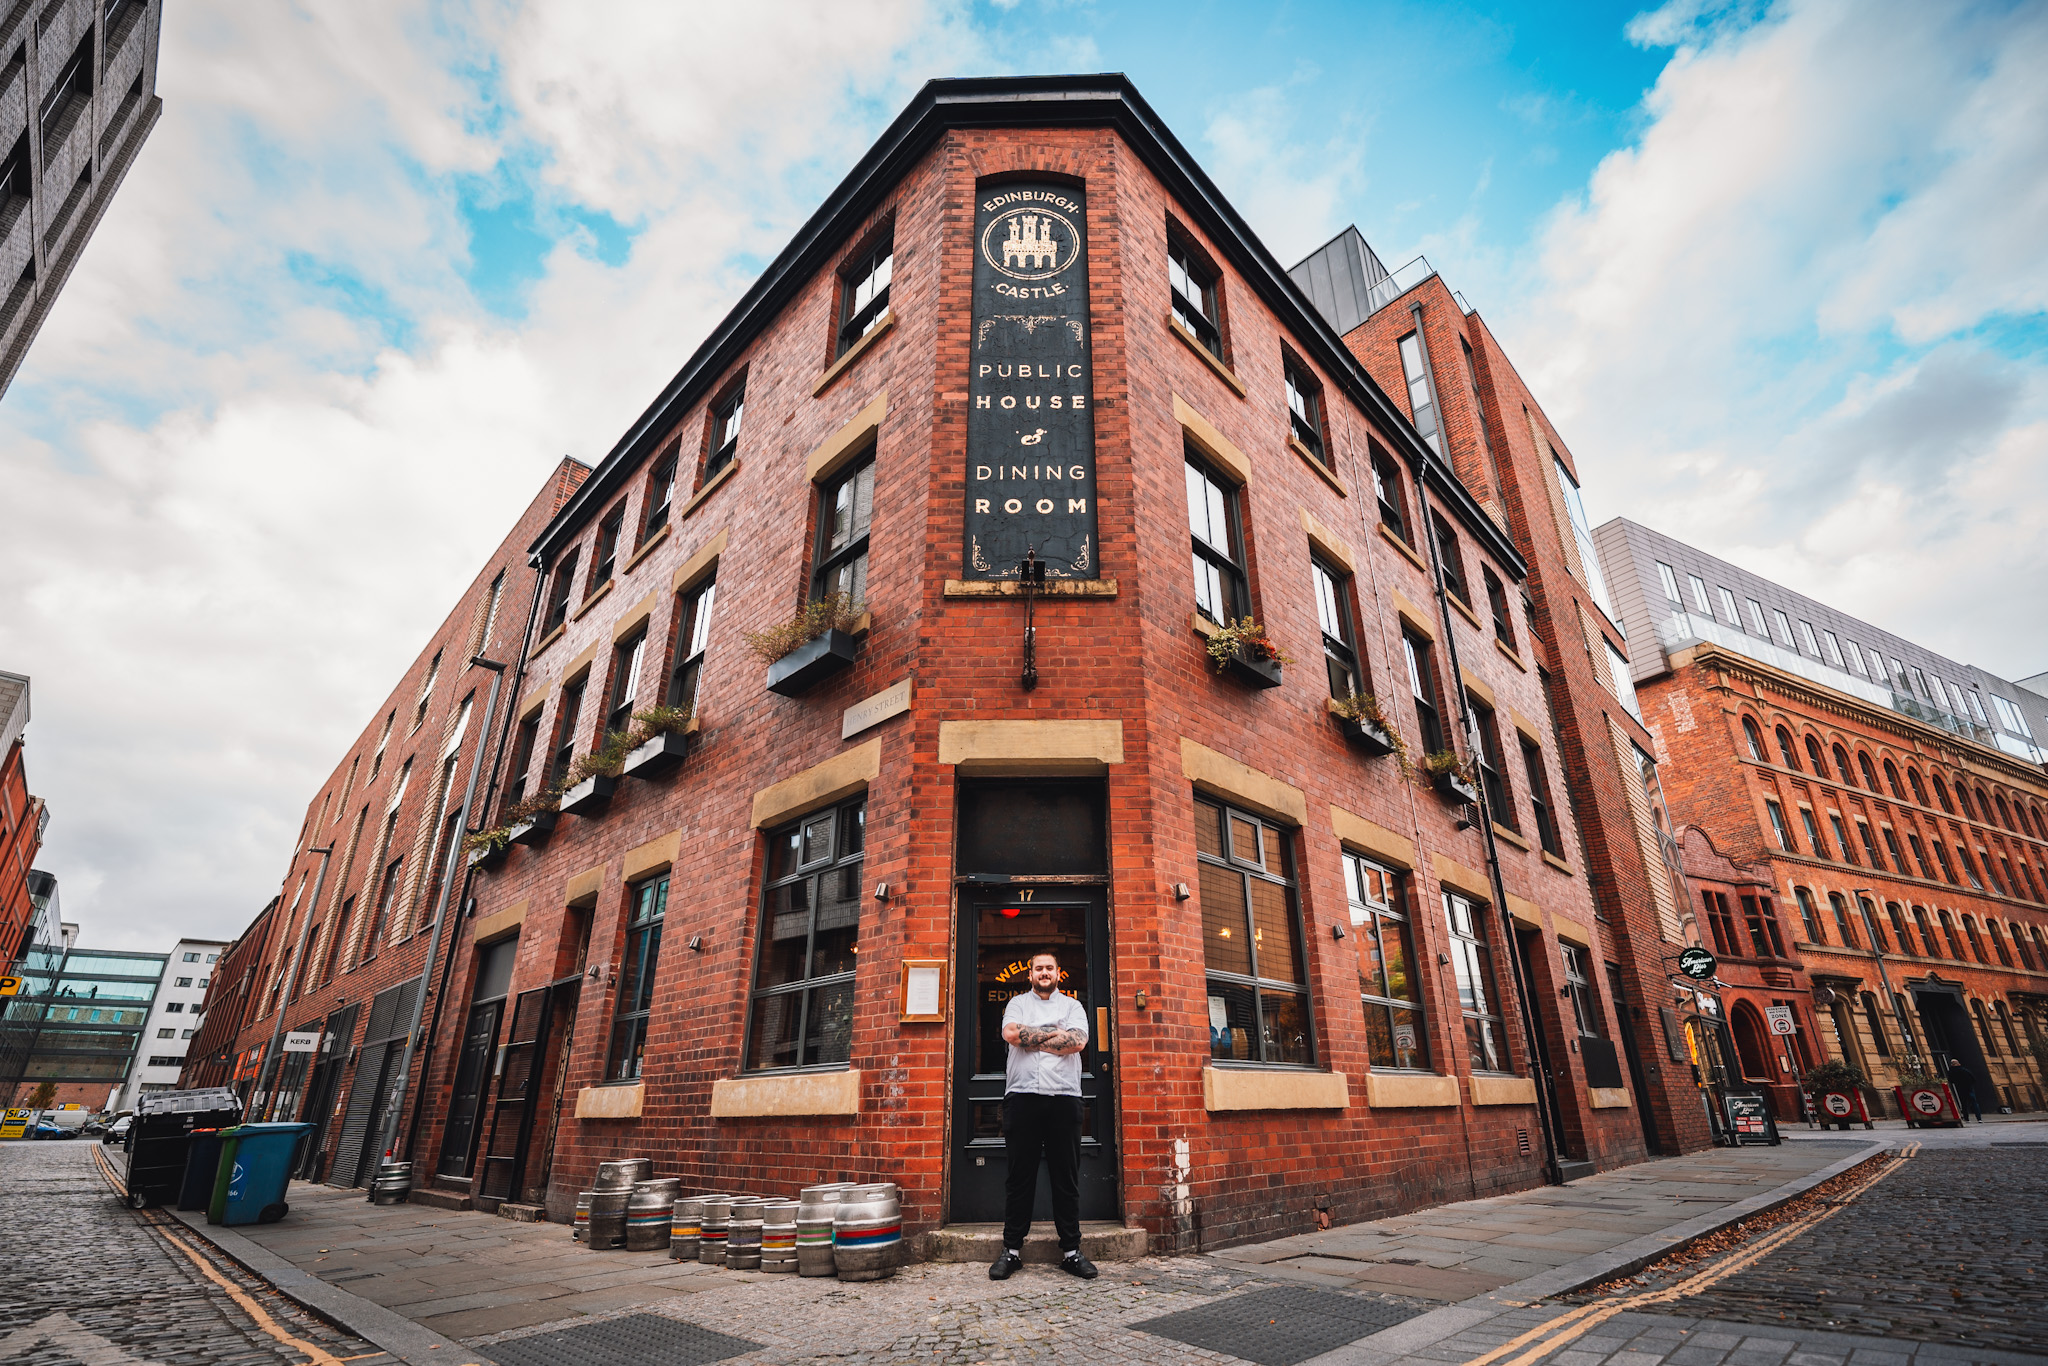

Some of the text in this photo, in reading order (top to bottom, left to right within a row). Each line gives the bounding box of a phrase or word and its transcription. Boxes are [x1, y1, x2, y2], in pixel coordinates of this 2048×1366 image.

[983, 191, 1079, 214] EDINBURGH
[996, 283, 1066, 299] CASTLE
[979, 364, 1082, 378] PUBLIC
[976, 395, 1085, 409] HOUSE
[976, 465, 1085, 480] DINING
[975, 498, 1087, 514] ROOM
[847, 691, 906, 728] HENRY STREET
[1019, 889, 1034, 902] 17
[1681, 957, 1712, 968] American
[995, 959, 1069, 983] WELE
[1732, 1101, 1759, 1109] American
